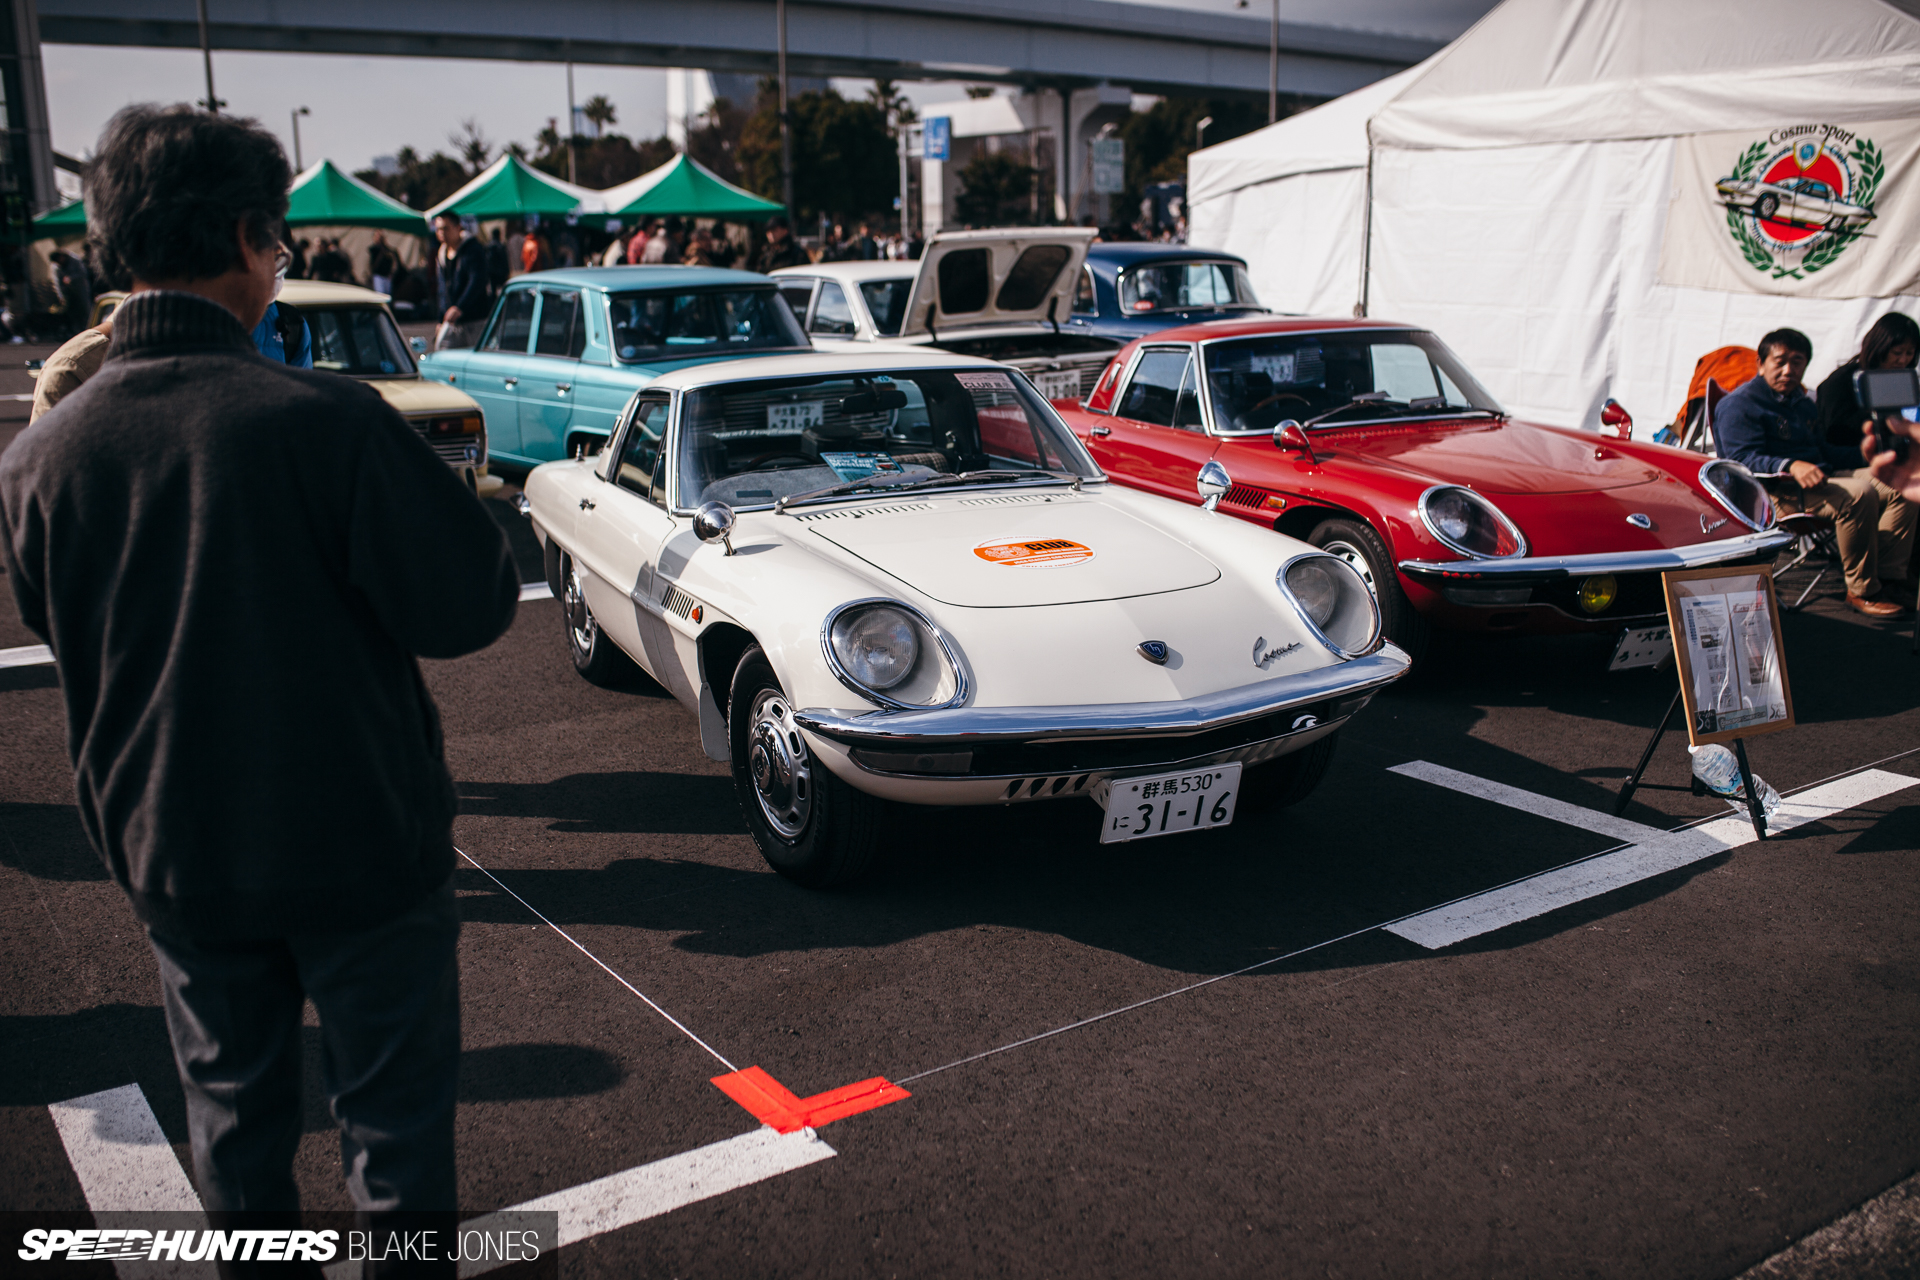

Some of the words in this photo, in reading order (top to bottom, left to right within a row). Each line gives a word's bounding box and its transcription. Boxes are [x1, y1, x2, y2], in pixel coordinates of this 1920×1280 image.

[1820, 124, 1856, 145] Sport
[1024, 540, 1074, 550] CLUB
[1252, 636, 1300, 668] Cosmo
[1112, 816, 1130, 831] に
[1132, 791, 1231, 835] 31-16
